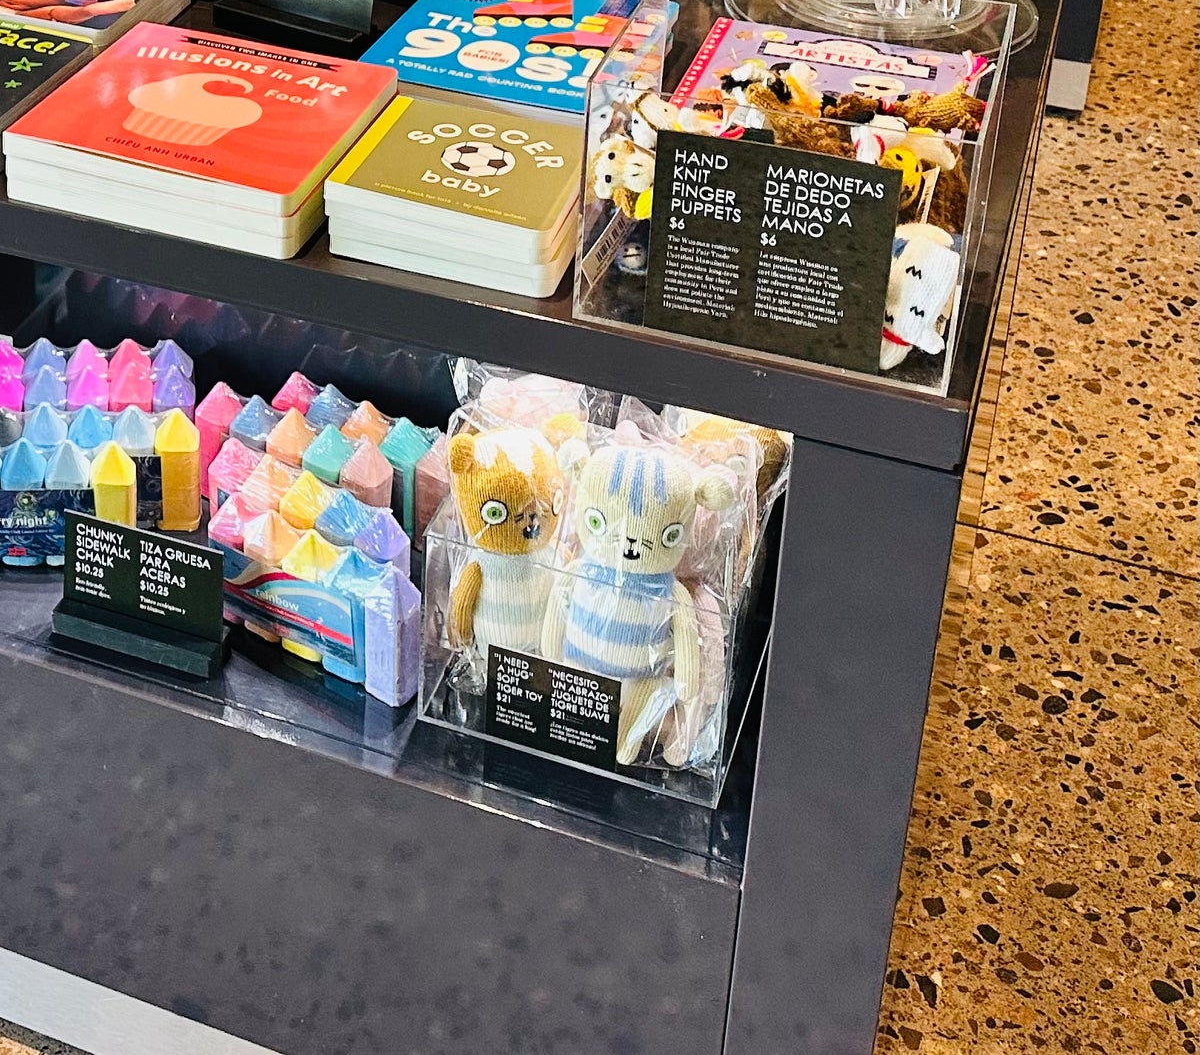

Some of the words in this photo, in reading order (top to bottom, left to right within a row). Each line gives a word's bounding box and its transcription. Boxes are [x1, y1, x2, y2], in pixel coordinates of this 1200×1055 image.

[426, 11, 498, 37] The
[477, 48, 504, 58] FOR
[789, 47, 905, 72] ARTISTAS
[136, 45, 269, 75] Illusions
[270, 68, 293, 82] in
[296, 75, 349, 97] Art
[385, 57, 395, 65] A
[397, 60, 447, 74] TOTALLY
[447, 69, 474, 79] RAD
[477, 75, 543, 93] COUNTING
[547, 87, 585, 98] BOOK
[263, 88, 319, 108] Food
[144, 146, 170, 156] ANH
[174, 152, 216, 166] URBAN
[407, 122, 565, 169] SOCCER
[674, 148, 729, 170] HAND
[420, 169, 501, 198] baby
[673, 165, 711, 184] KNIT
[766, 164, 885, 199] MARIONETAS
[672, 182, 737, 205] FINGER
[765, 180, 792, 198] DE
[794, 186, 851, 209] DEDO
[671, 198, 742, 223] PUPPETS
[763, 196, 833, 223] TEJIDAS
[837, 212, 852, 227] A
[669, 216, 686, 230] $6
[761, 214, 824, 238] MANO
[759, 232, 777, 247] $6
[15, 515, 48, 528] night
[75, 523, 124, 545] CHUNKY
[75, 536, 131, 561] SIDEWALK
[75, 548, 114, 568] CHALK
[139, 540, 163, 558] TIZA
[164, 548, 212, 571] GRUESA
[75, 562, 104, 579] $10.25
[139, 553, 171, 572] PARA
[139, 567, 187, 589] ACERAS
[139, 580, 170, 597] $10.25
[255, 588, 299, 612] rainbow
[496, 664, 505, 673] A
[503, 655, 530, 670] NEED
[496, 672, 520, 687] SOFT
[551, 680, 567, 691] UN
[496, 682, 523, 697] TIGER
[525, 689, 543, 703] TOY
[496, 692, 511, 704] $21
[551, 689, 594, 709] JUGUETE
[595, 701, 610, 714] DE
[550, 698, 578, 714] TIGRE
[579, 706, 611, 724] SUAVE
[550, 708, 566, 721] $21
